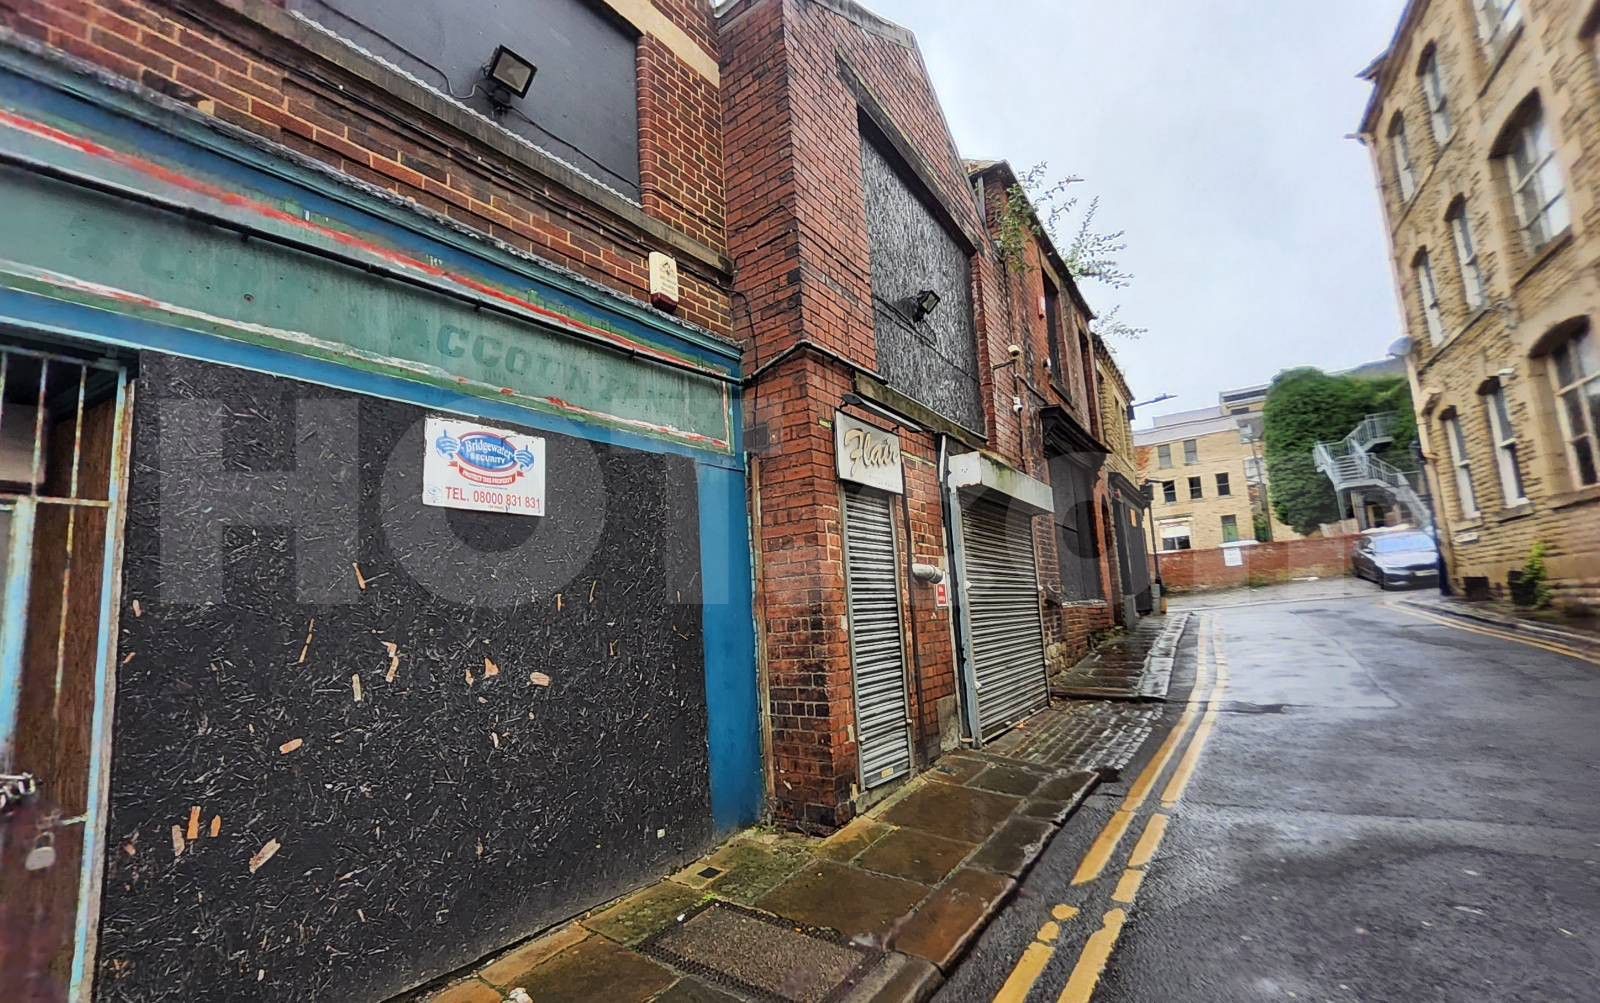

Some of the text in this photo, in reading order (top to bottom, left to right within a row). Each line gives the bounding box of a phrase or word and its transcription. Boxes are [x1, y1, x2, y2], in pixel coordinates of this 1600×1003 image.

[465, 438, 512, 459] Bridgewater
[469, 452, 506, 464] SECURITY
[445, 486, 469, 502] TEL.
[473, 490, 503, 505] 08000
[505, 494, 521, 506] 831
[525, 496, 540, 509] 831
